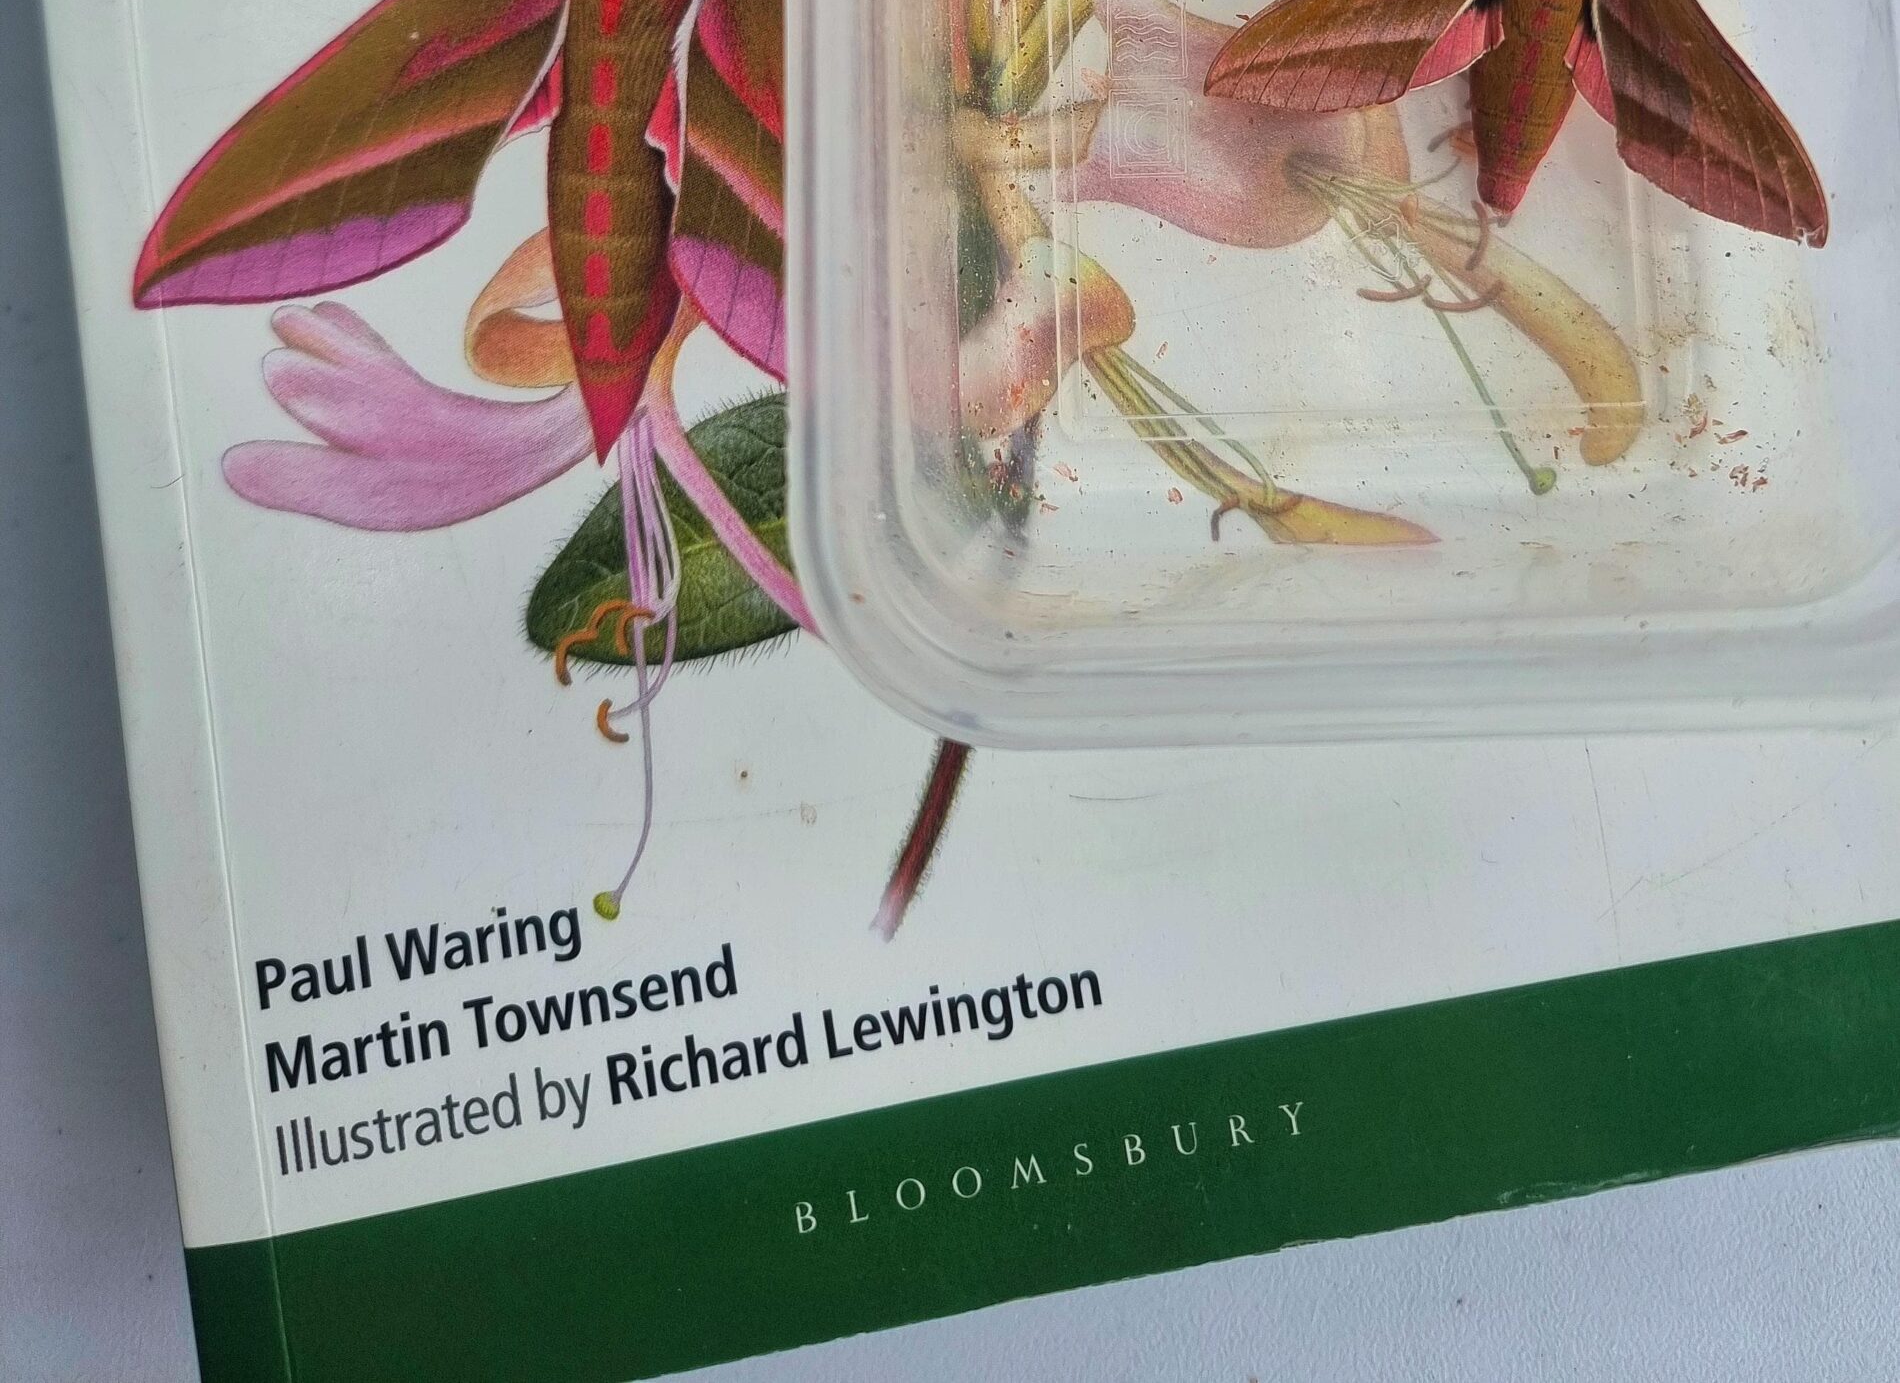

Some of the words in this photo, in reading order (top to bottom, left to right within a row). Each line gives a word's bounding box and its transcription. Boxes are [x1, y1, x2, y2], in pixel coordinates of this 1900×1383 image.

[255, 935, 372, 1011] Paul
[384, 907, 582, 982] Waring
[264, 1011, 451, 1094] Martin
[462, 942, 738, 1049] Townsend
[275, 1072, 523, 1176] Illustrated
[534, 1070, 591, 1130] by
[606, 1011, 809, 1106] Richard
[822, 969, 1103, 1060] Lewington
[795, 1101, 1303, 1234] BLOOMSBURY
